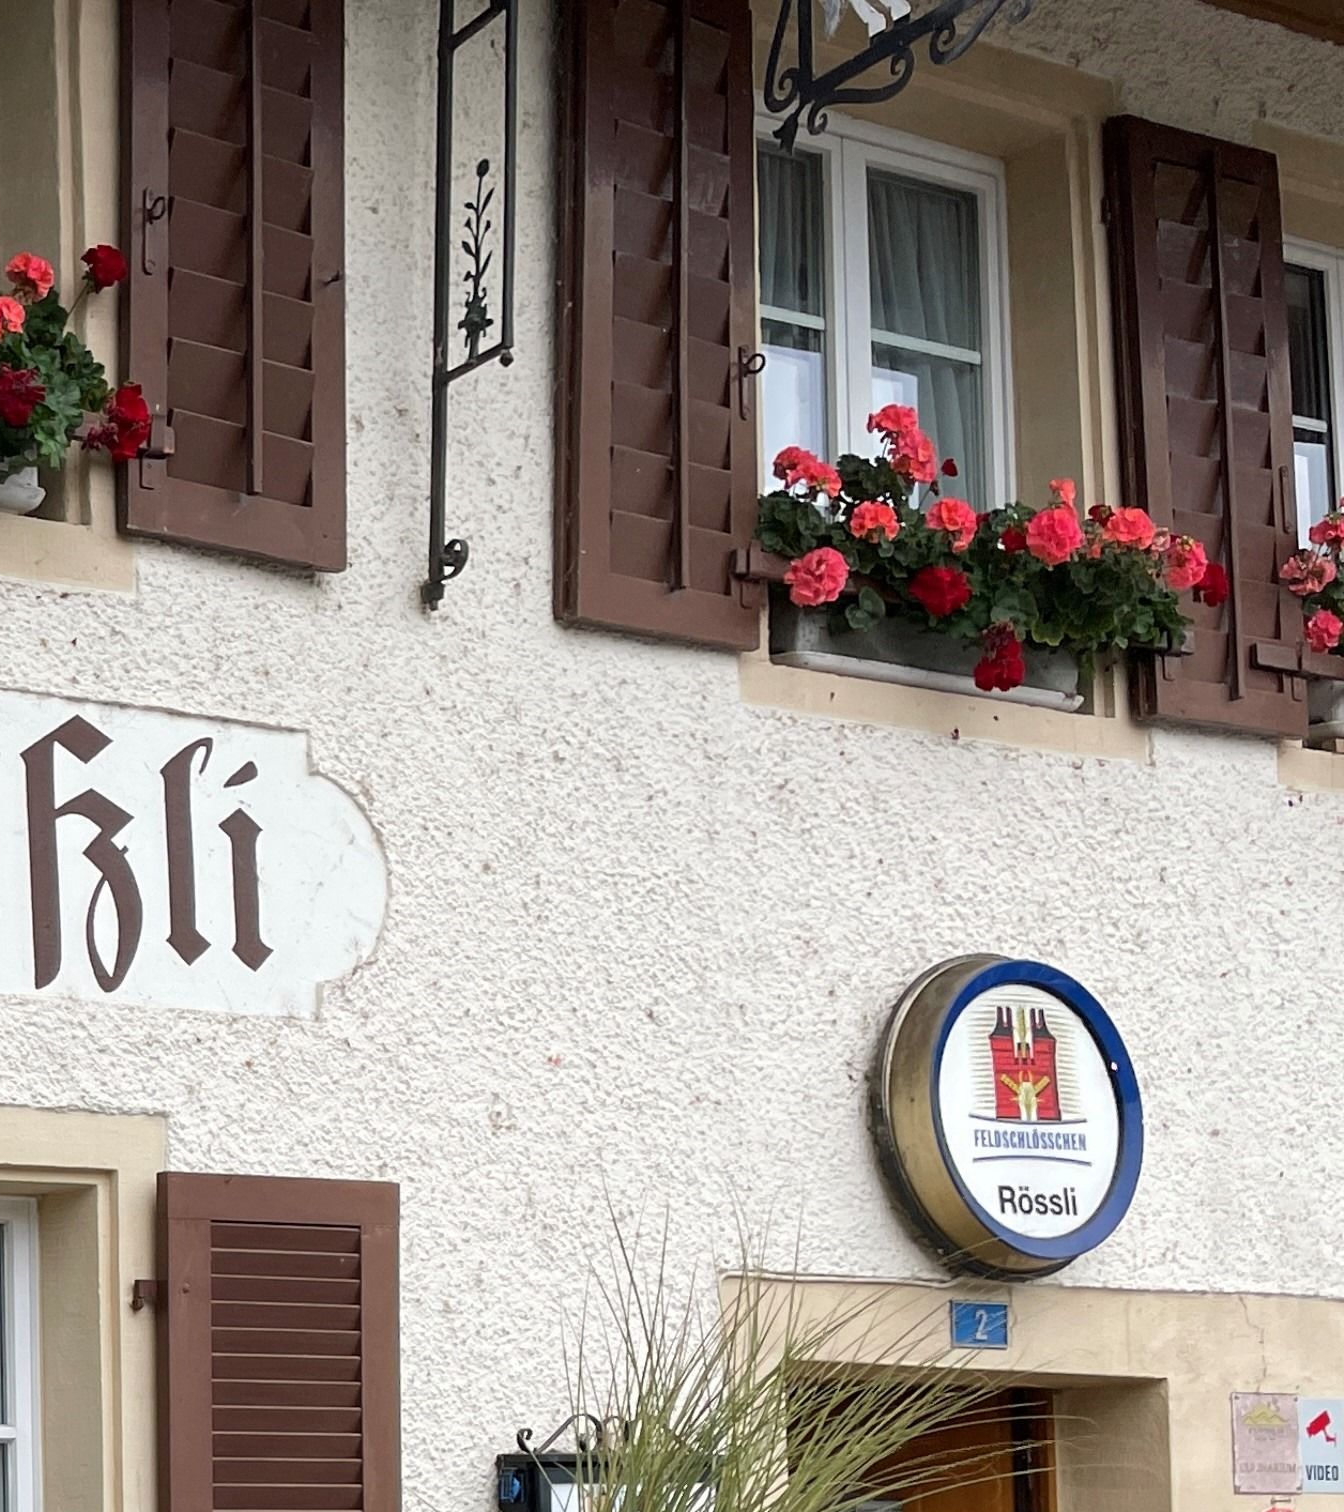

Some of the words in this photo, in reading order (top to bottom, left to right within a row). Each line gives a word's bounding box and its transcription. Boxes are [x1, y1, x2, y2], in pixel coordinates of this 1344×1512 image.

[974, 1129, 1087, 1151] FELDSCHLÖSSCHEN
[998, 1186, 1078, 1216] Rössli
[975, 1309, 988, 1340] 2
[1305, 1464, 1339, 1481] VIDEO
